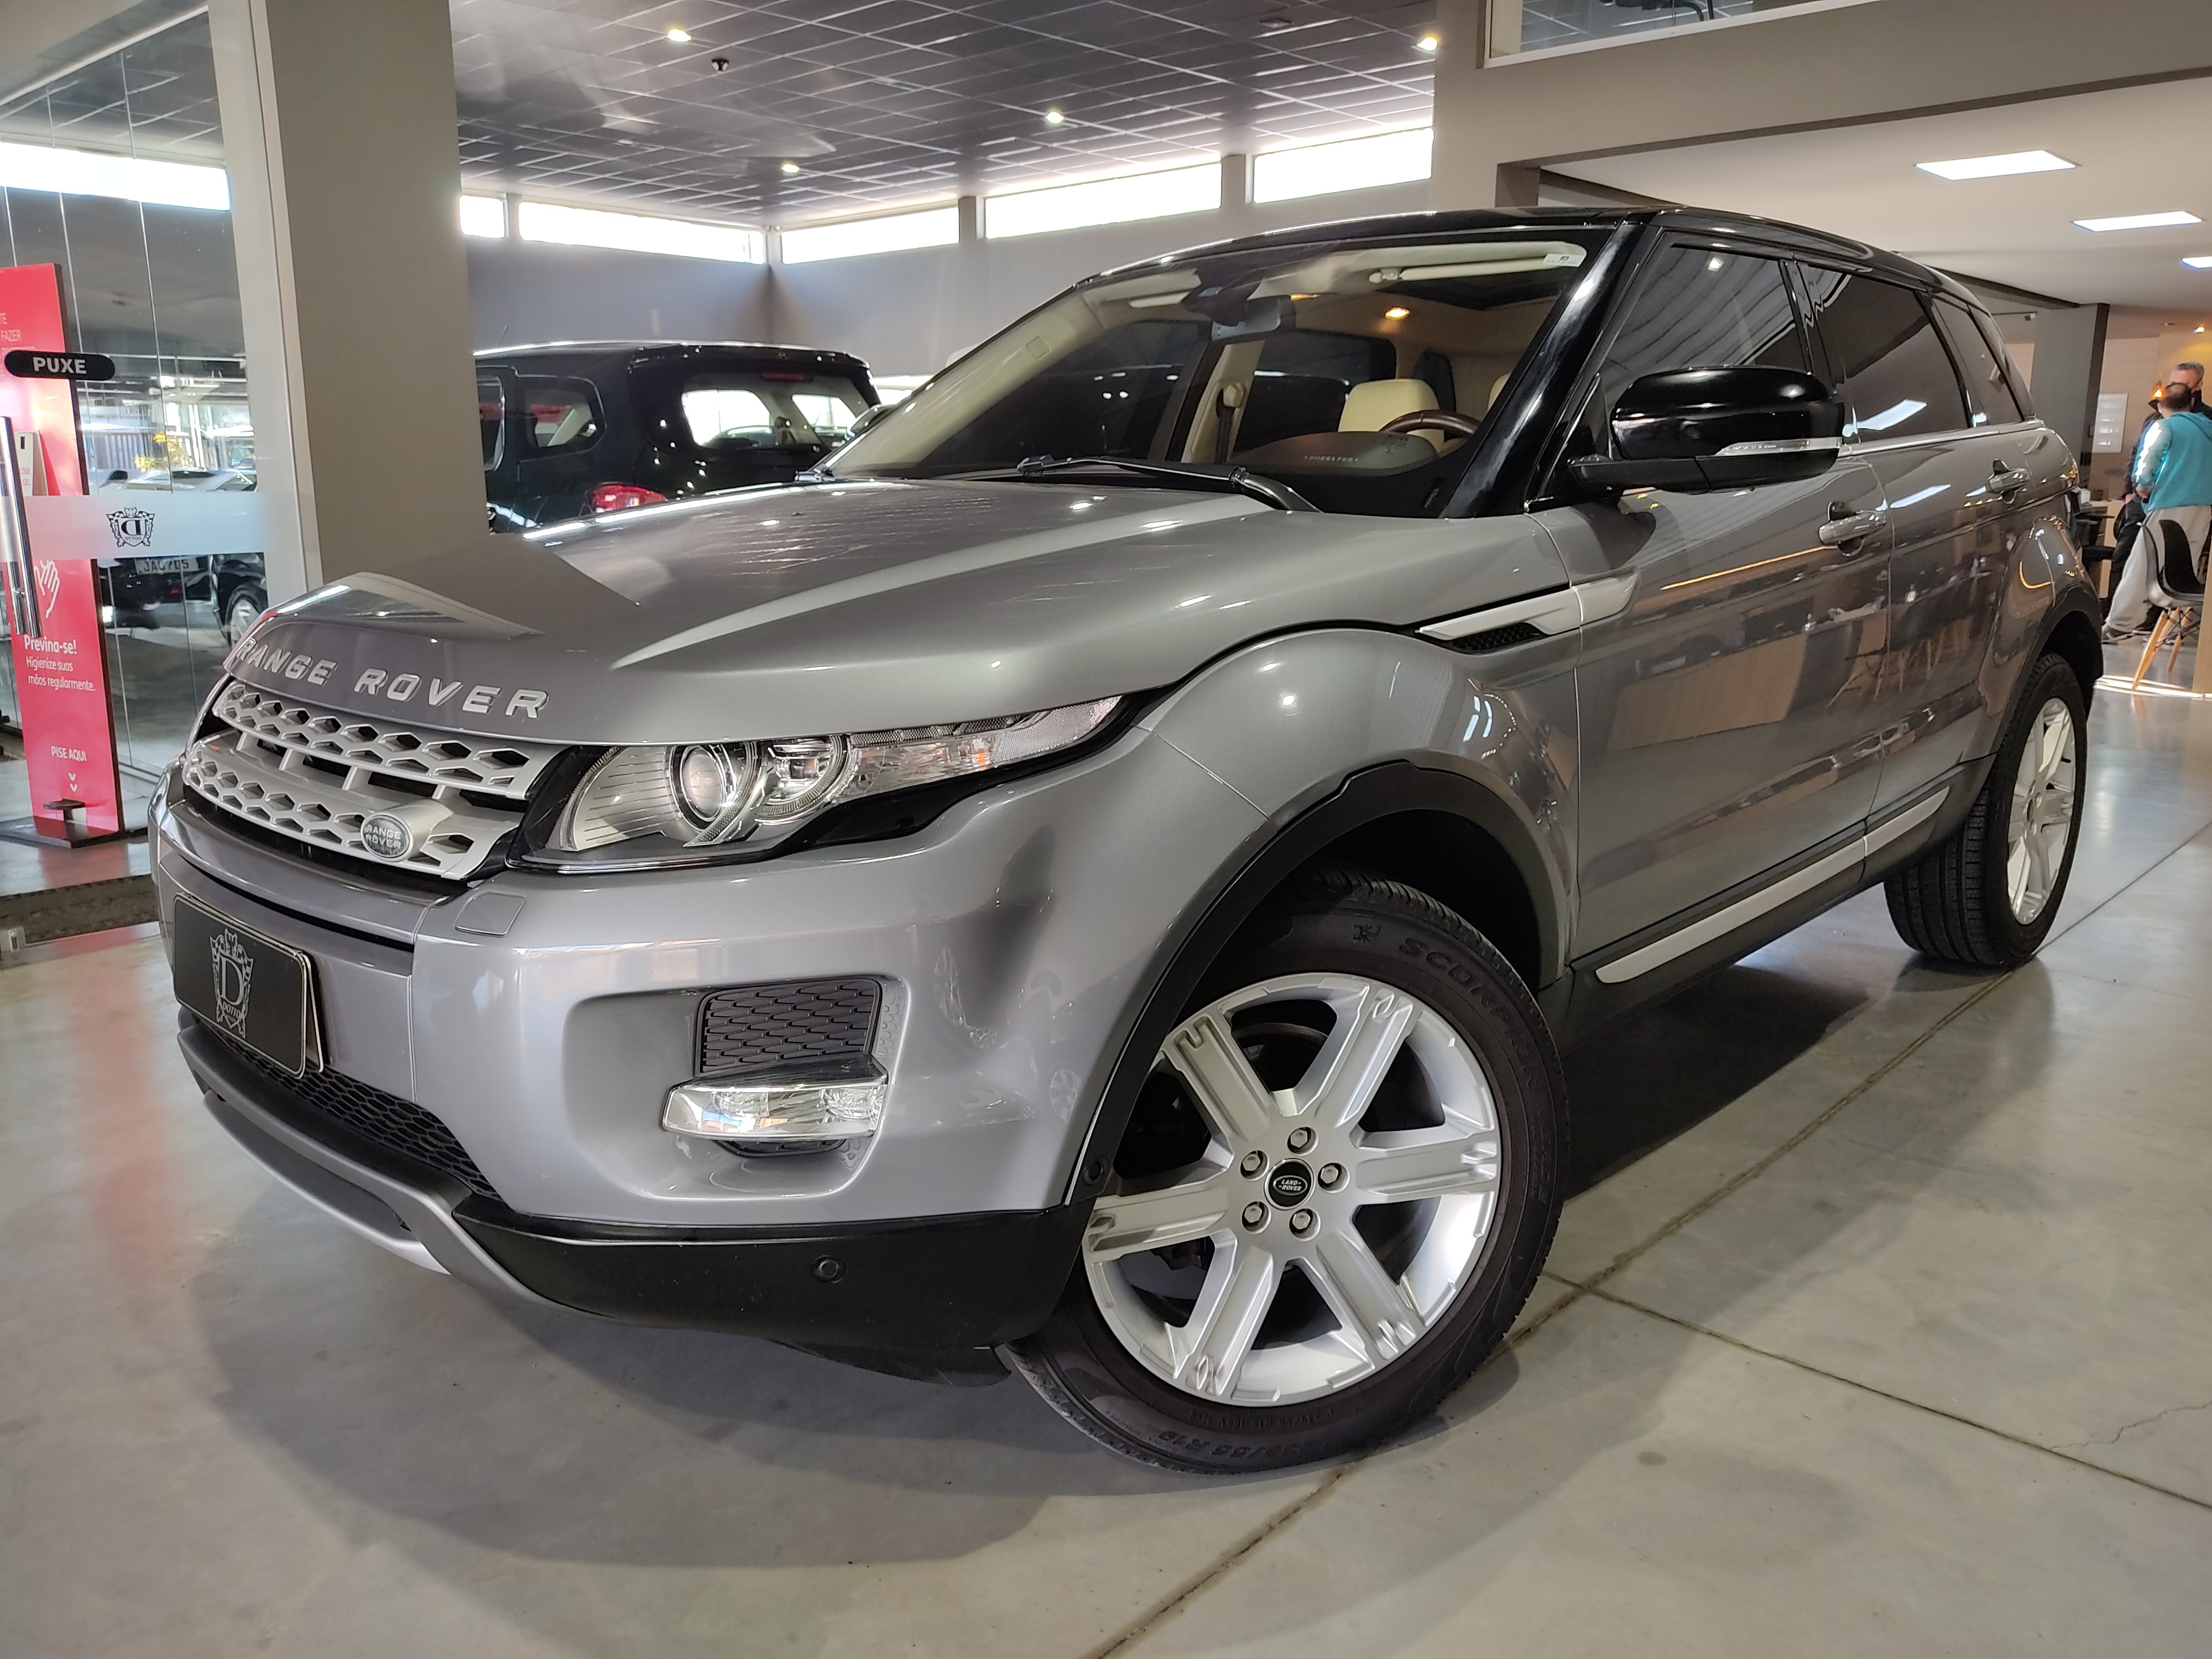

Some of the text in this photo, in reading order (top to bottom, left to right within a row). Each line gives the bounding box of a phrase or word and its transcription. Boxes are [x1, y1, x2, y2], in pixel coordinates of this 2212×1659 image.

[1, 329, 22, 342] FAZER
[33, 356, 87, 374] PUXE
[24, 635, 77, 655] Previna-se!
[26, 655, 74, 672] Higienize suas
[28, 673, 96, 691] mãos regularmente.
[236, 637, 549, 719] RANGE ROVER
[51, 745, 87, 761] PISE AQUI
[364, 824, 401, 840] RANGE
[366, 834, 401, 849] ROVER
[222, 1001, 241, 1019] DOTTO
